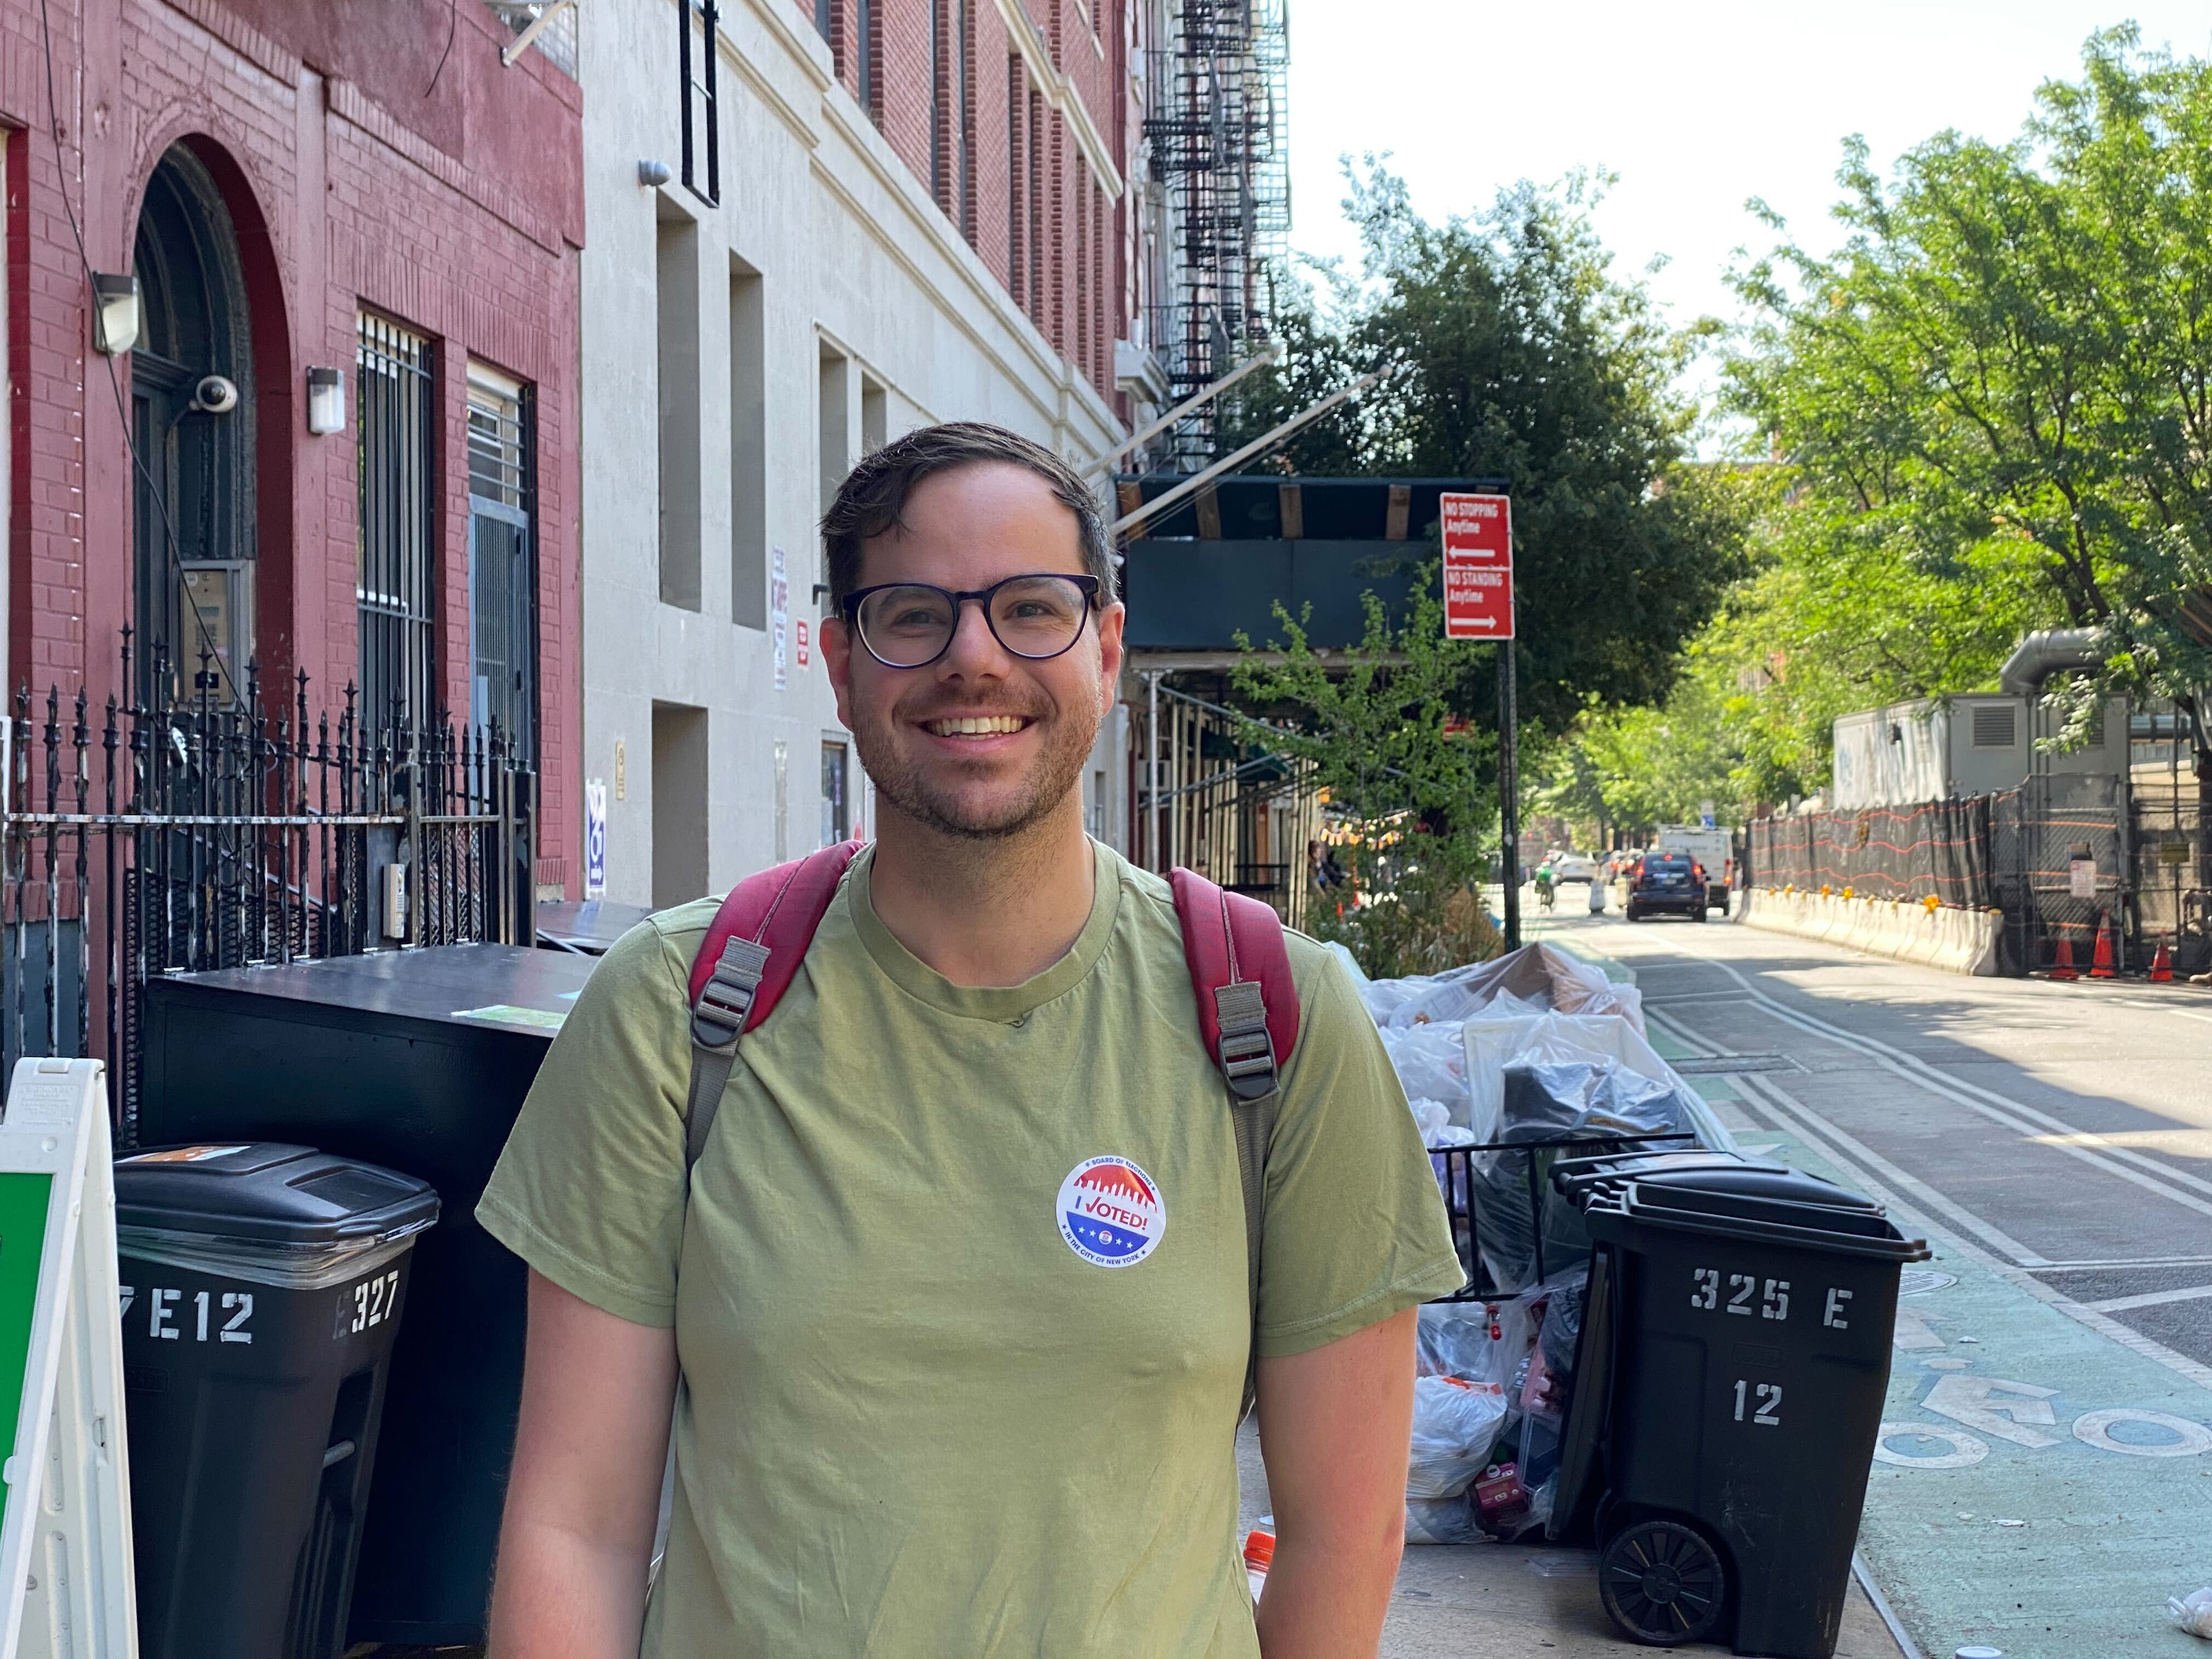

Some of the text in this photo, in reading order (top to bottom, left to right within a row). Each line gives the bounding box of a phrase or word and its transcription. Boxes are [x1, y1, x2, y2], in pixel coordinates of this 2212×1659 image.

[1445, 502, 1498, 518] NO STOPPING
[1447, 519, 1481, 536] Anytime
[1447, 571, 1502, 587] NO STANDING
[1449, 589, 1483, 605] Anytime
[1092, 1157, 1114, 1165] BOARD
[1126, 1161, 1153, 1186] ELECTIONS
[1075, 1195, 1148, 1231] I VOTED!
[1071, 1239, 1081, 1252] THE
[1080, 1249, 1094, 1260] CITY
[1122, 1253, 1140, 1264] YORK
[1691, 1268, 1854, 1329] 325 E
[1733, 1379, 1782, 1426] 12
